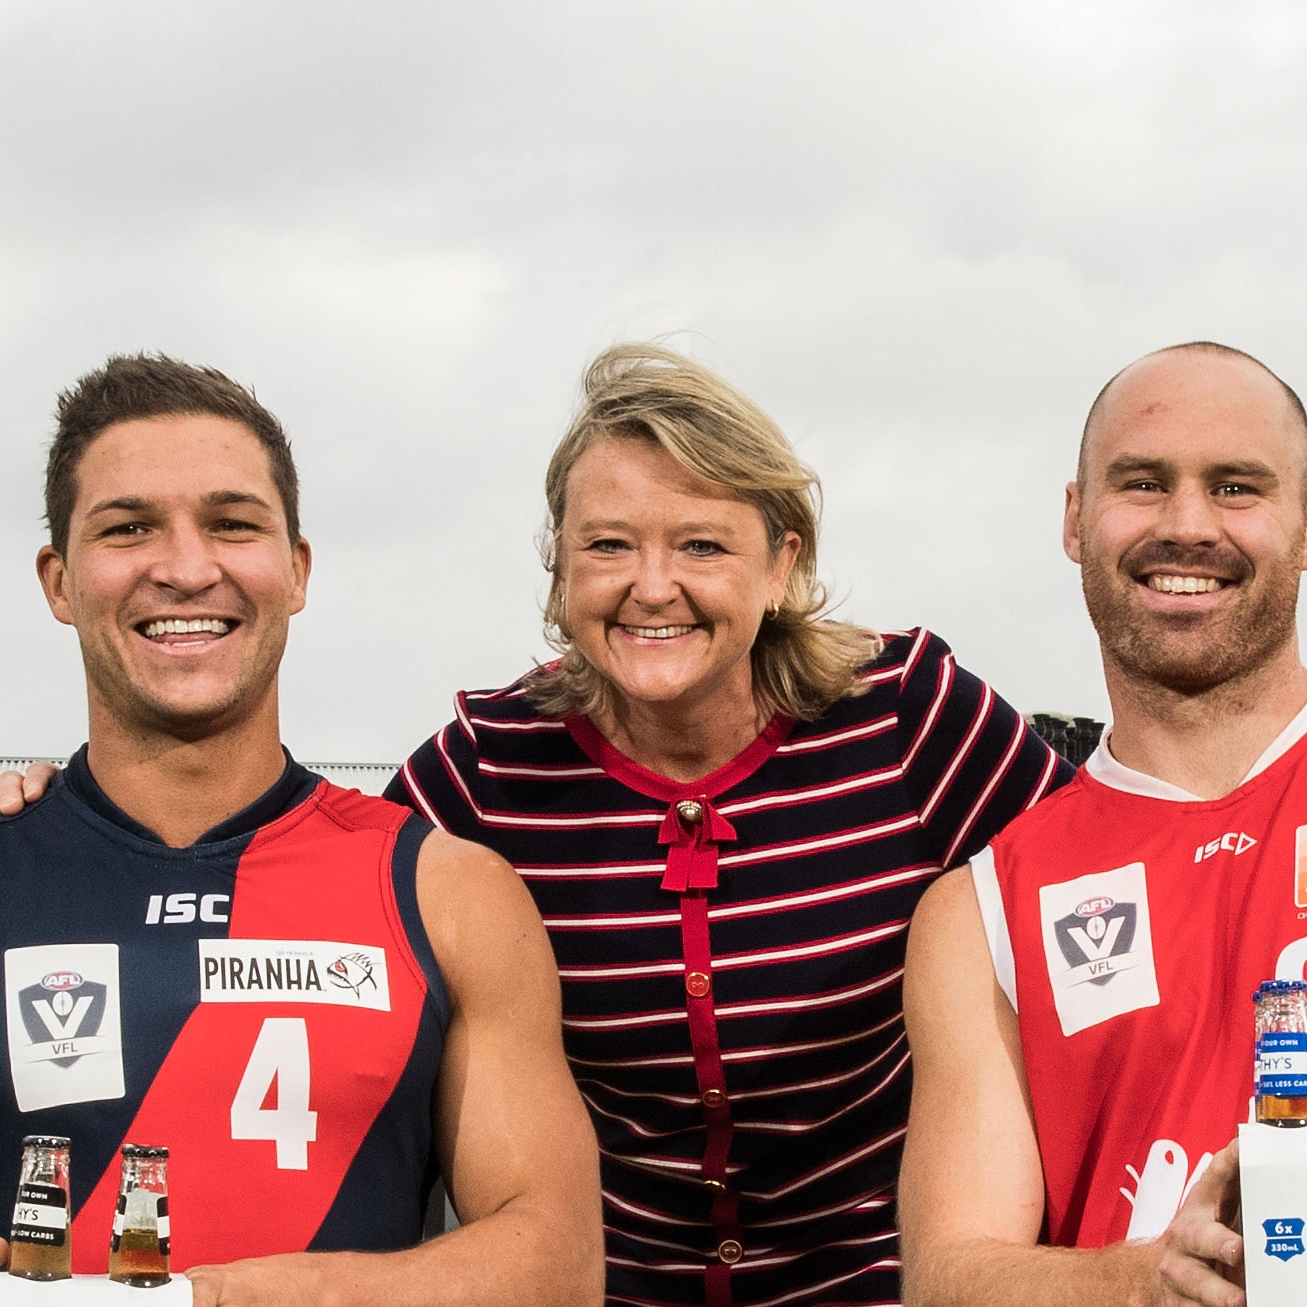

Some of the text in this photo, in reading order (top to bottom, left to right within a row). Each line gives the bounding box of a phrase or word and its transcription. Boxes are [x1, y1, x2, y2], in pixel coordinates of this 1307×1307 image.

[1194, 832, 1240, 864] ISC
[145, 893, 230, 924] ISC
[1078, 897, 1110, 915] AFL
[204, 957, 322, 991] PIRANHA
[1088, 962, 1114, 975] VFL
[45, 974, 80, 988] AFL
[52, 1041, 79, 1055] VFL
[231, 1018, 317, 1170] 4
[1275, 1222, 1293, 1234] 6x
